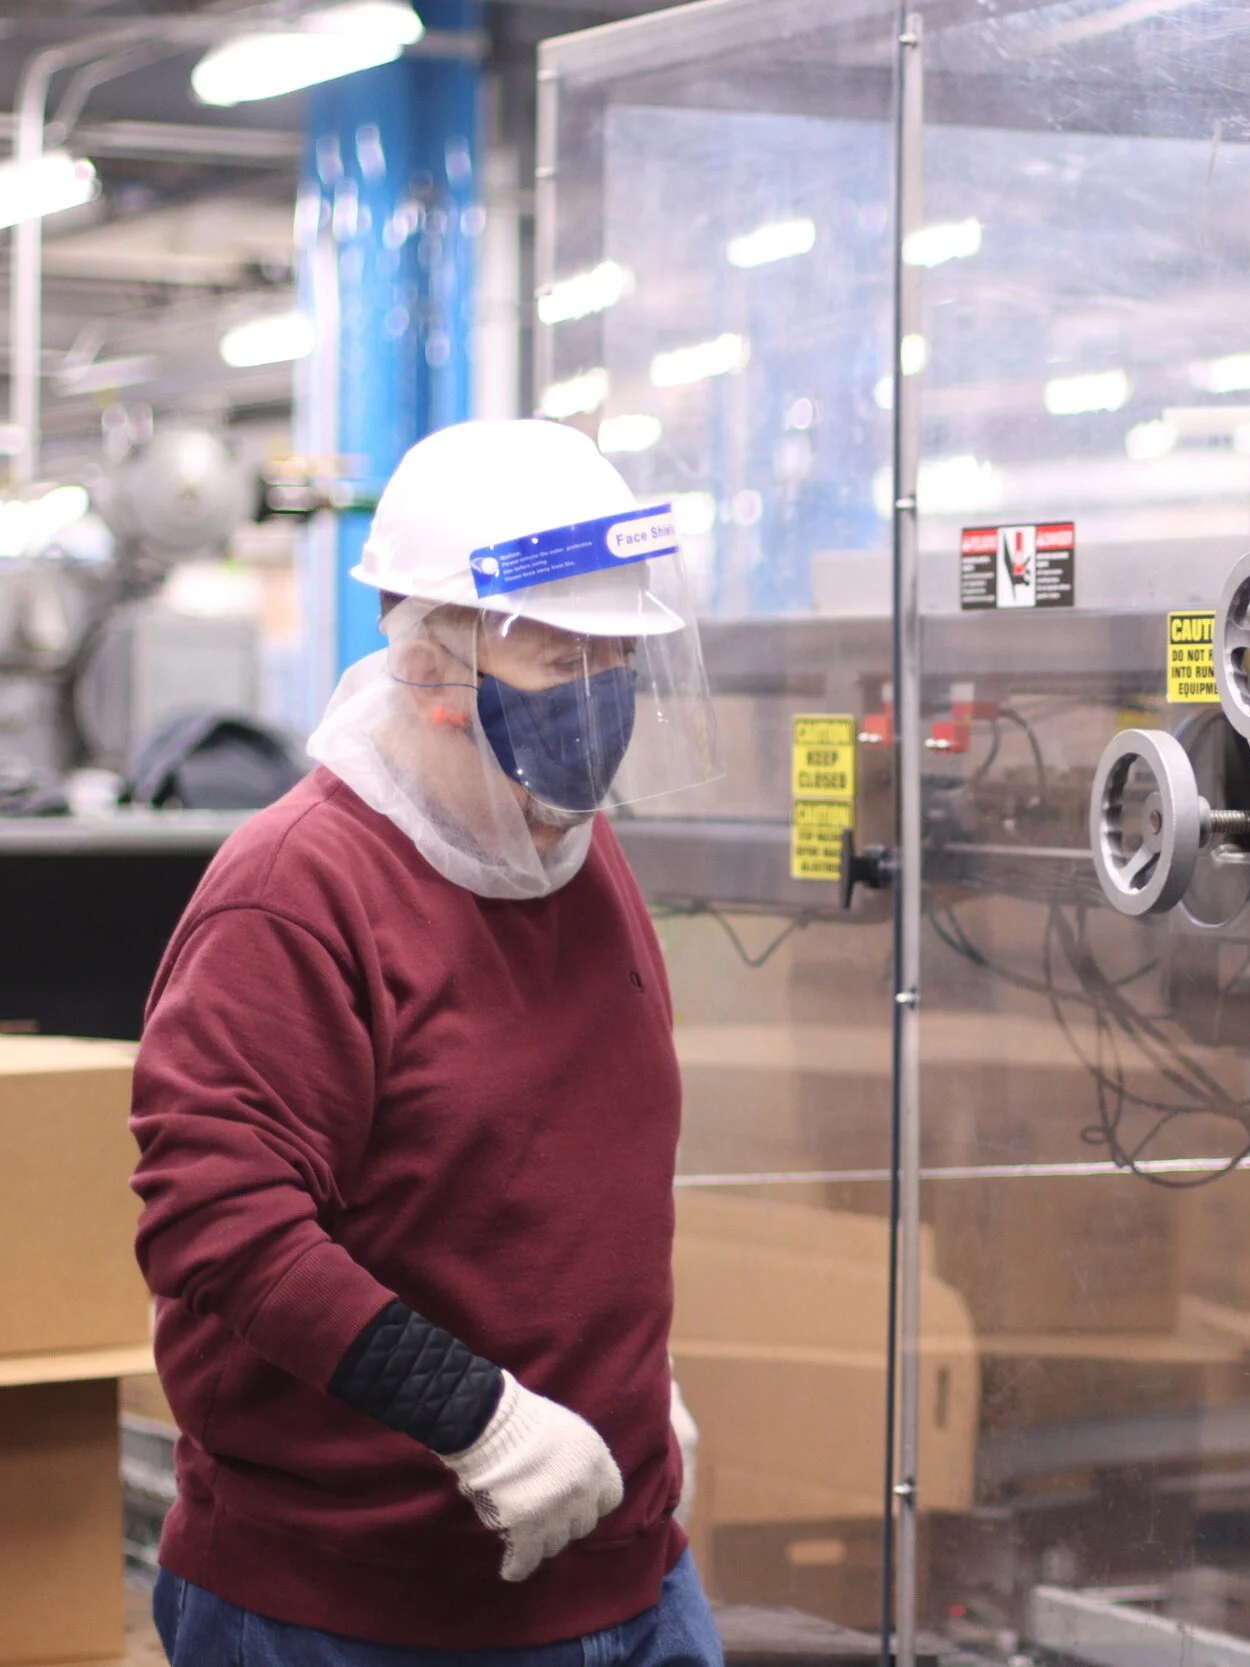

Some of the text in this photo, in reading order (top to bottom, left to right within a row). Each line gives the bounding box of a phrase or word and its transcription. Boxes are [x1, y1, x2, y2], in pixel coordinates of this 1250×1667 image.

[615, 529, 648, 547] Face
[1172, 649, 1184, 662] DO
[1187, 649, 1205, 662] NOT
[1171, 666, 1192, 679] INTO
[806, 750, 839, 767] KEEP
[798, 771, 847, 789] CLOSED
